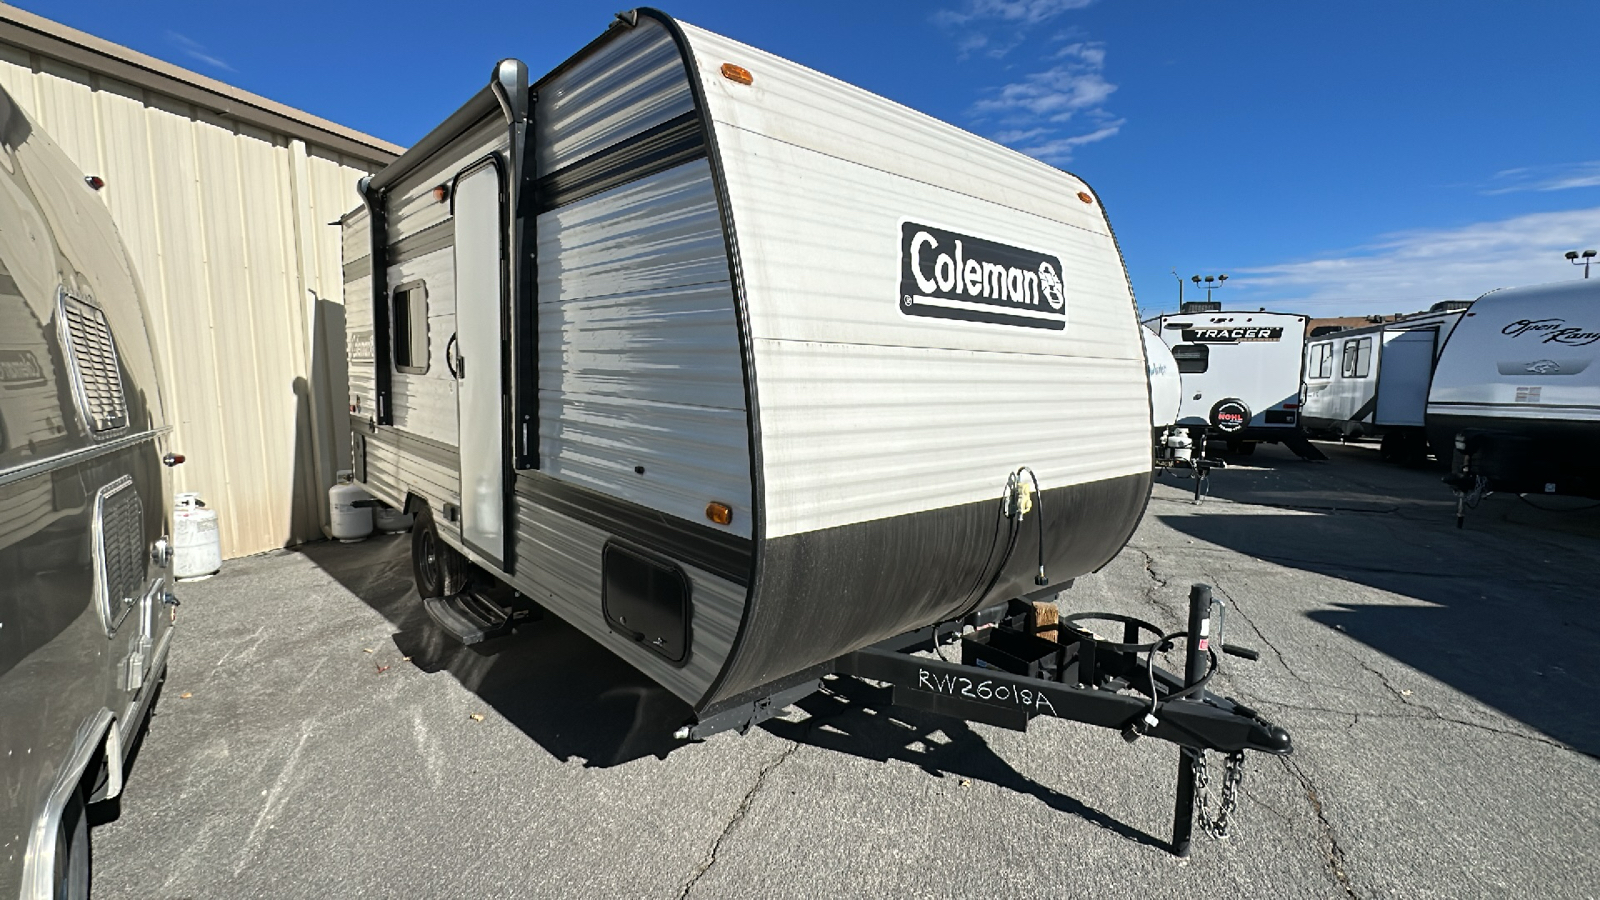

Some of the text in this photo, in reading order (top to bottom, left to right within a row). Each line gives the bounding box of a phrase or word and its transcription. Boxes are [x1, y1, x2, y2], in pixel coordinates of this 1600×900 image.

[910, 231, 1039, 305] Coleman
[1194, 329, 1271, 338] TRACER
[1502, 319, 1565, 338] Open
[919, 668, 1058, 717] RW26018A
